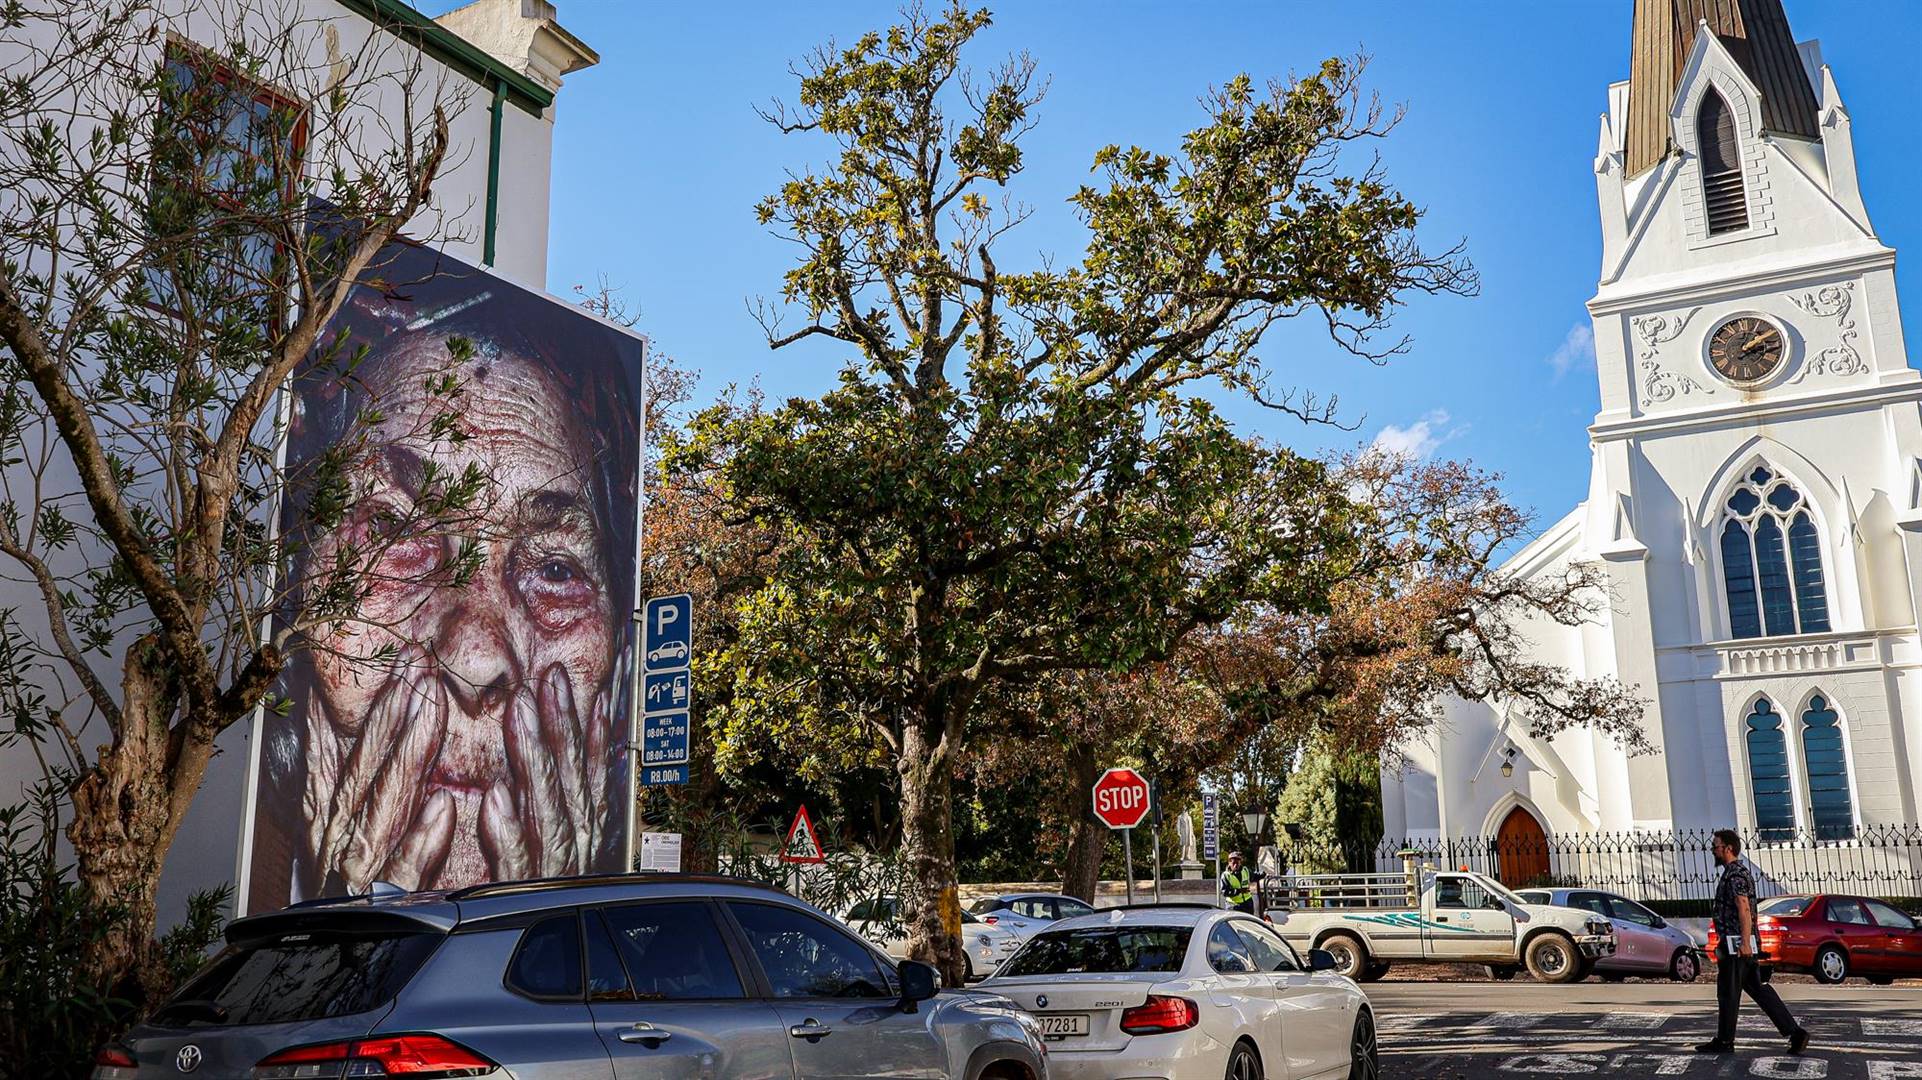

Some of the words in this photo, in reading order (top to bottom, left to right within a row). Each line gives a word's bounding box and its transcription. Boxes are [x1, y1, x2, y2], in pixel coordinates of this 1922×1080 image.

[658, 604, 679, 636] P
[659, 717, 673, 726] WEEK
[661, 740, 670, 748] SAT
[650, 769, 680, 783] R8.00/h
[1099, 785, 1144, 812] STOP
[1205, 796, 1212, 806] P
